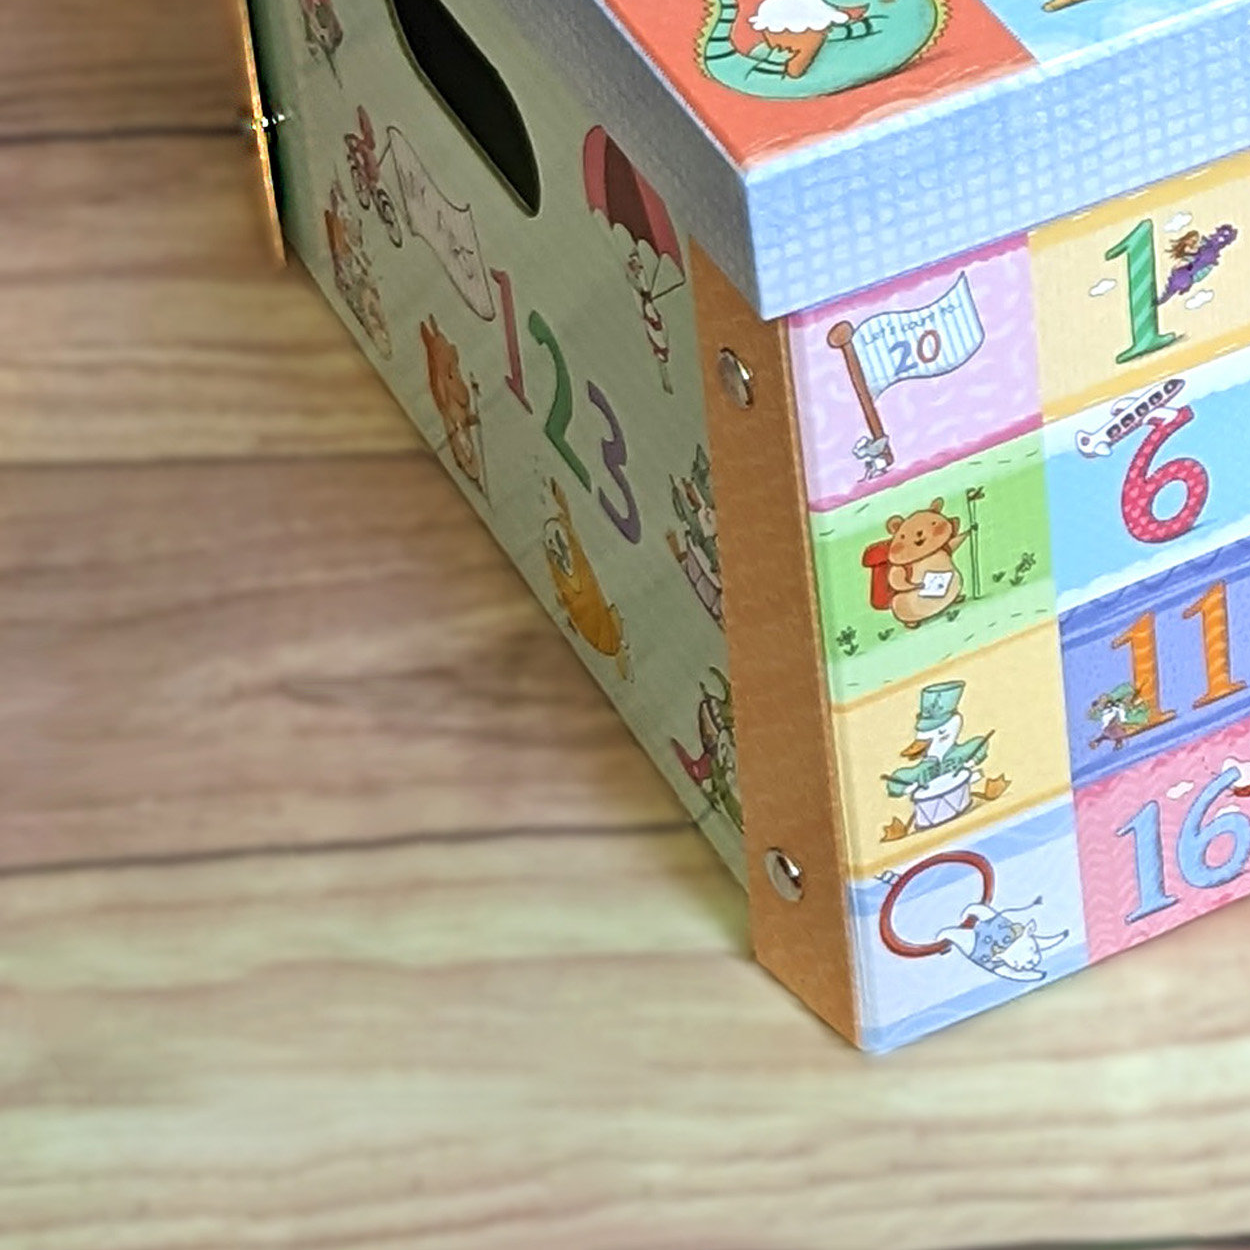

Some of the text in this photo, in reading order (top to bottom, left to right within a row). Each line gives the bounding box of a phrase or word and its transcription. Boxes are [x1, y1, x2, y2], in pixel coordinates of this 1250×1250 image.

[888, 329, 940, 377] 20
[1106, 219, 1178, 364] 1
[1121, 405, 1208, 543] 6
[1111, 580, 1247, 737] 11
